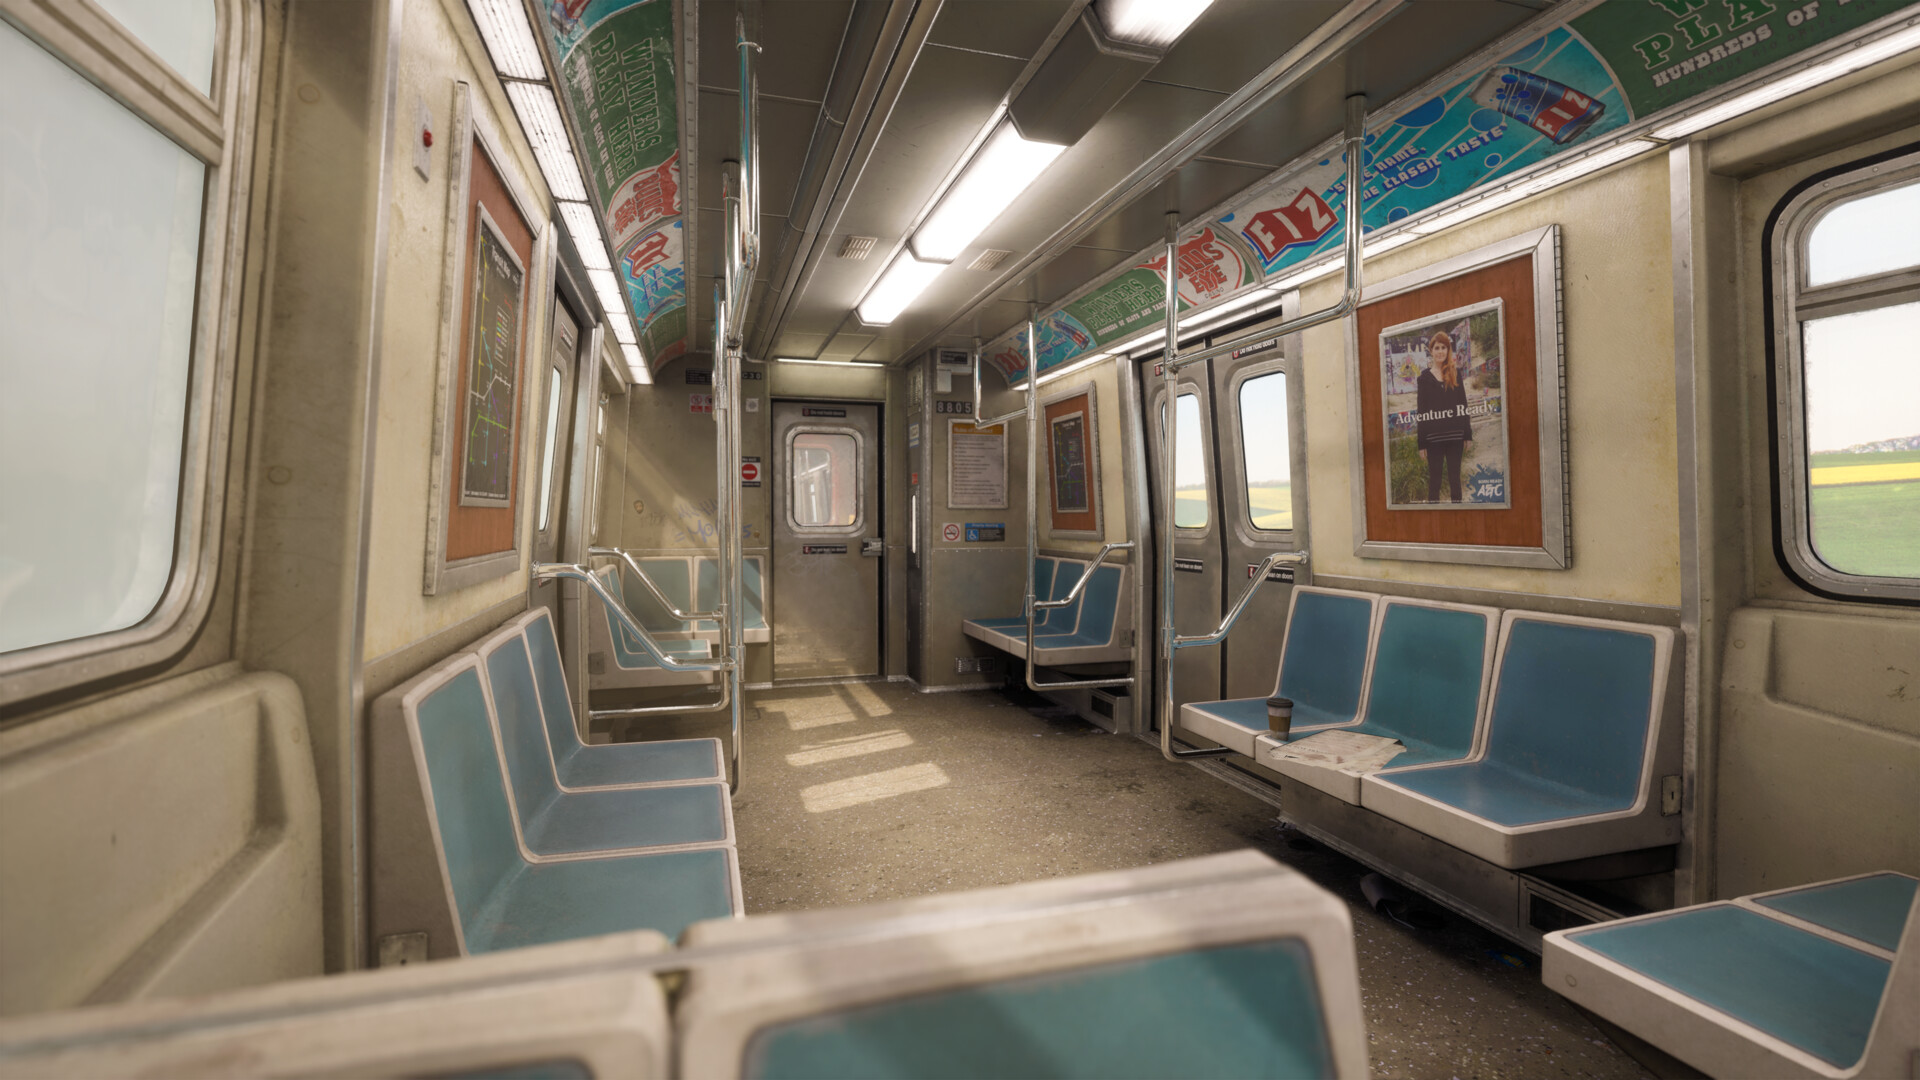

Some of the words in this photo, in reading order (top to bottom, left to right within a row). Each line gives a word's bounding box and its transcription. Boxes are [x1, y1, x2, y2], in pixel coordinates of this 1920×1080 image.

[1633, 0, 1801, 71] PLA
[1651, 24, 1773, 88] HUNDREDS
[1786, 0, 1821, 28] OF
[589, 31, 627, 115] PLAY
[608, 115, 637, 179] HERE
[621, 38, 663, 152] WINNERS
[1535, 89, 1593, 138] FIZ
[1383, 154, 1442, 193] CLASSIC
[614, 197, 636, 236] EYE
[633, 173, 665, 223] BULLS
[1251, 193, 1331, 254] FIZ
[1080, 278, 1146, 316] WINNERS
[1188, 262, 1228, 294] EYE
[1086, 304, 1122, 330] PLAY
[1123, 284, 1165, 312] HERE
[937, 401, 972, 413] 8805
[1396, 410, 1453, 425] Adventure
[1456, 400, 1497, 416] Ready.
